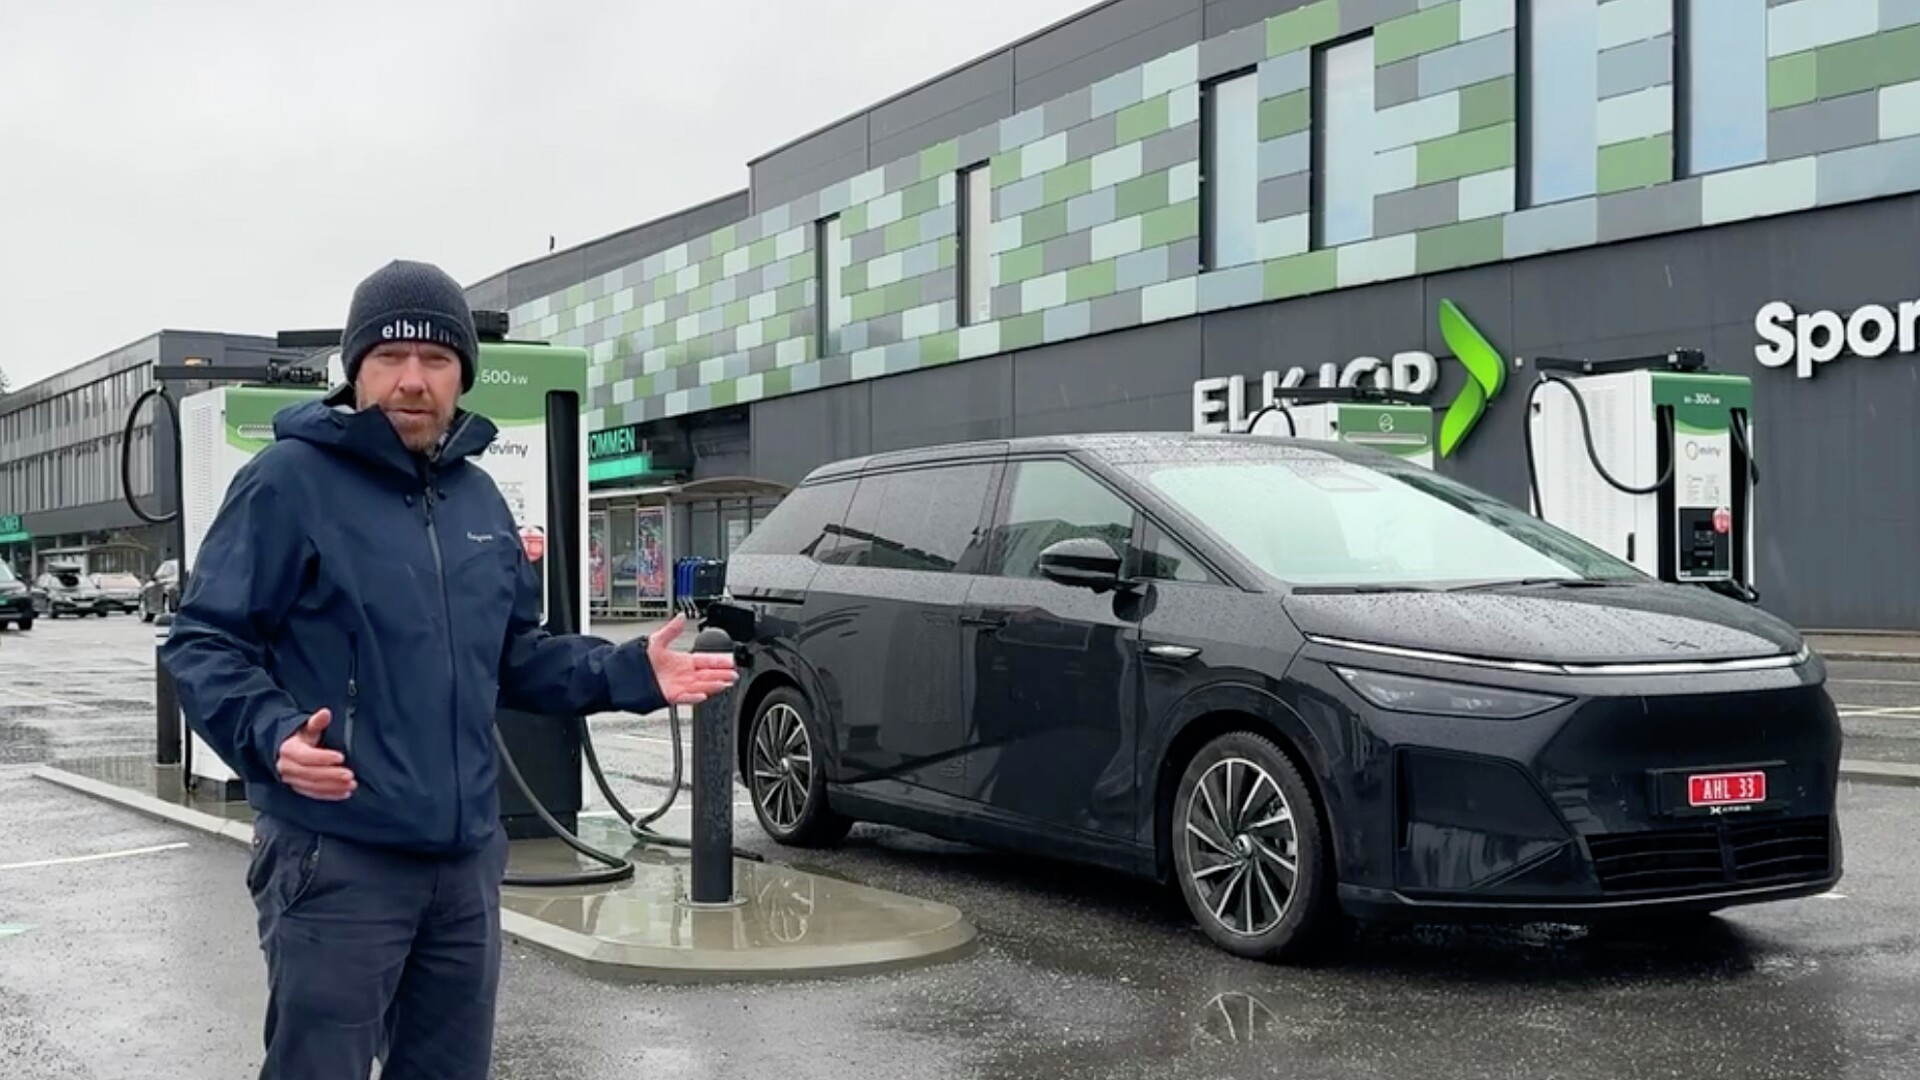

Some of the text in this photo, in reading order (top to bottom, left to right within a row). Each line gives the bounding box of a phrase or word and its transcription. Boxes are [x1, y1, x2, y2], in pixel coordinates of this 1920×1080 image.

[1754, 300, 1920, 378] Spor
[587, 426, 636, 459] OMMEN
[1703, 776, 1754, 800] AHL 33
